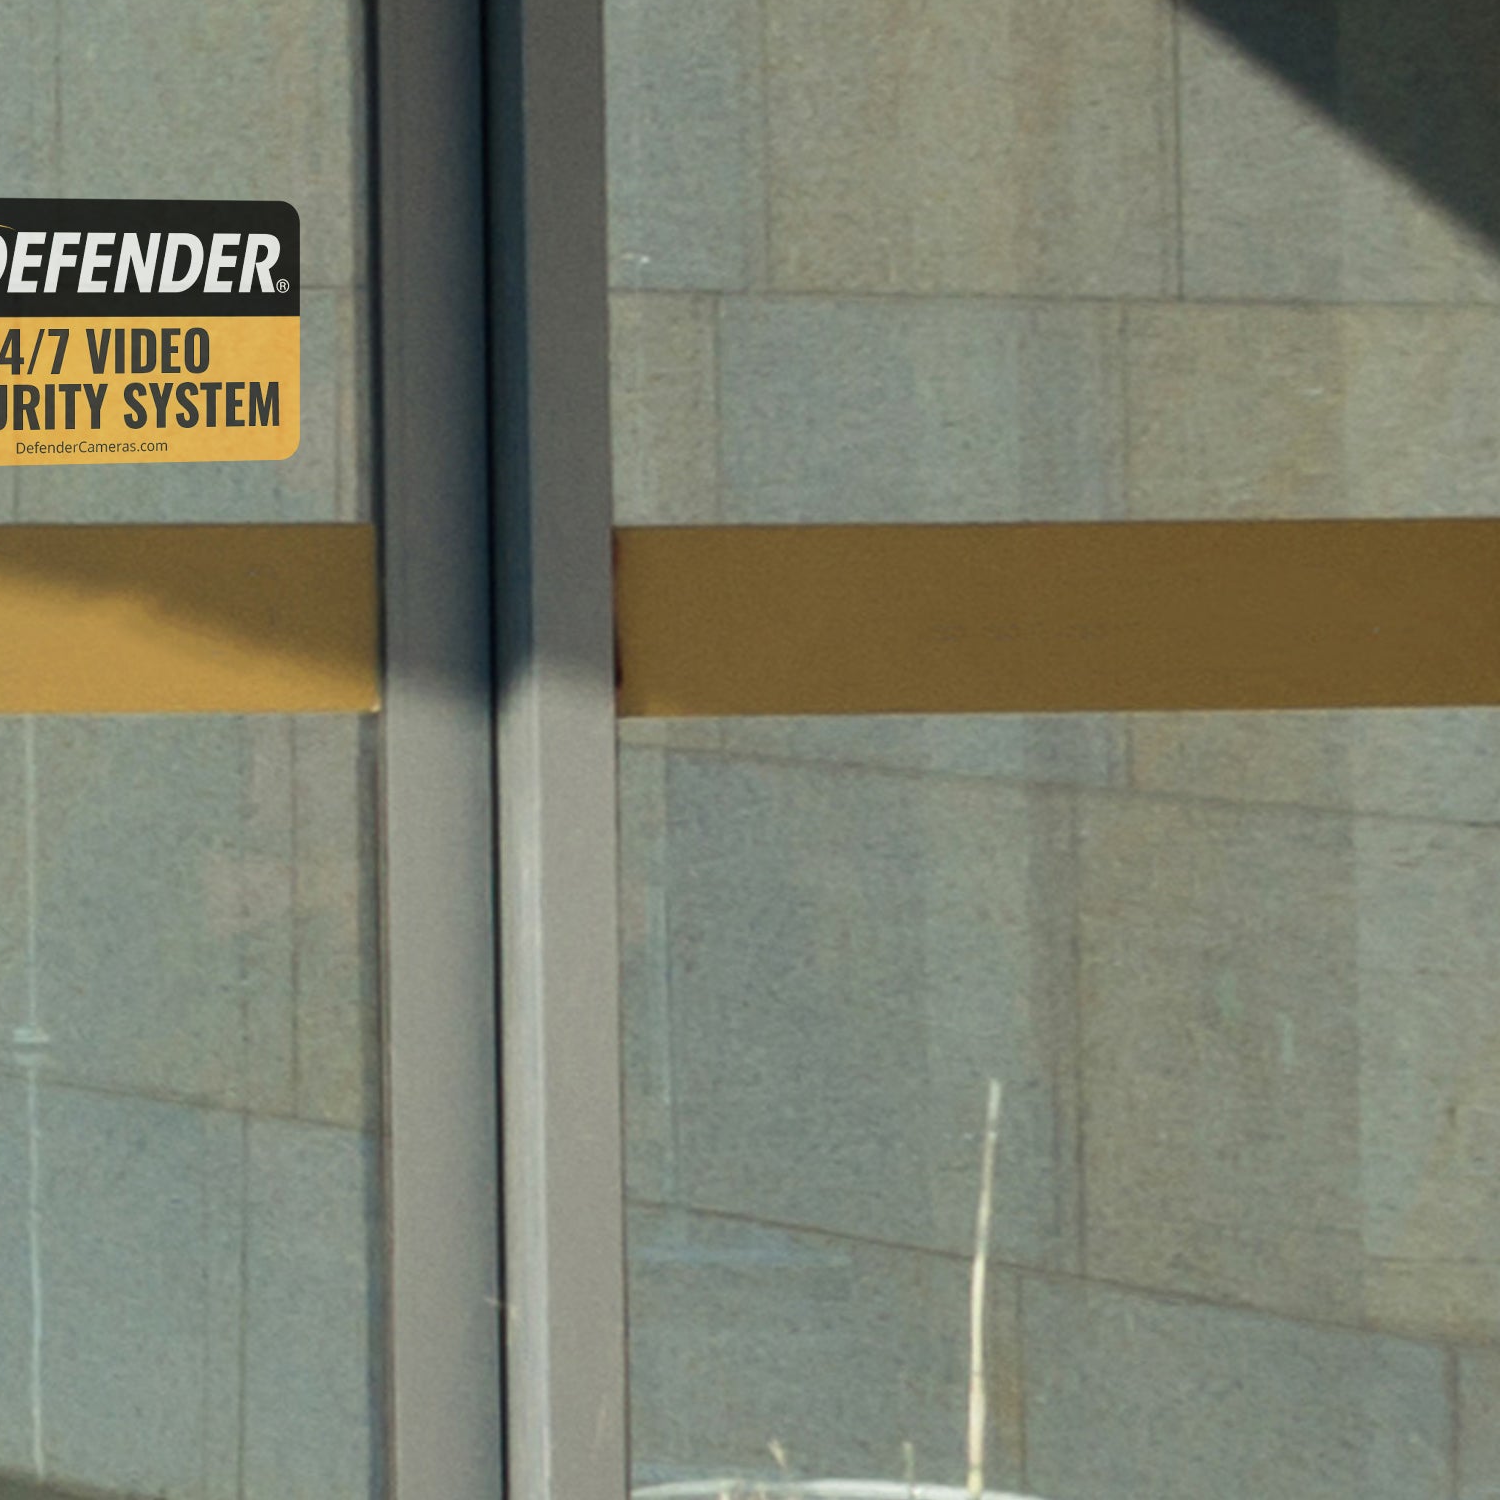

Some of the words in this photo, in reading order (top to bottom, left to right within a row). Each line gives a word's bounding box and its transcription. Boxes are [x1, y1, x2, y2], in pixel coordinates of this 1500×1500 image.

[86, 327, 210, 374] VIDEO
[123, 381, 280, 429] SYSTEM
[15, 440, 168, 455] DefenderCameras.com
